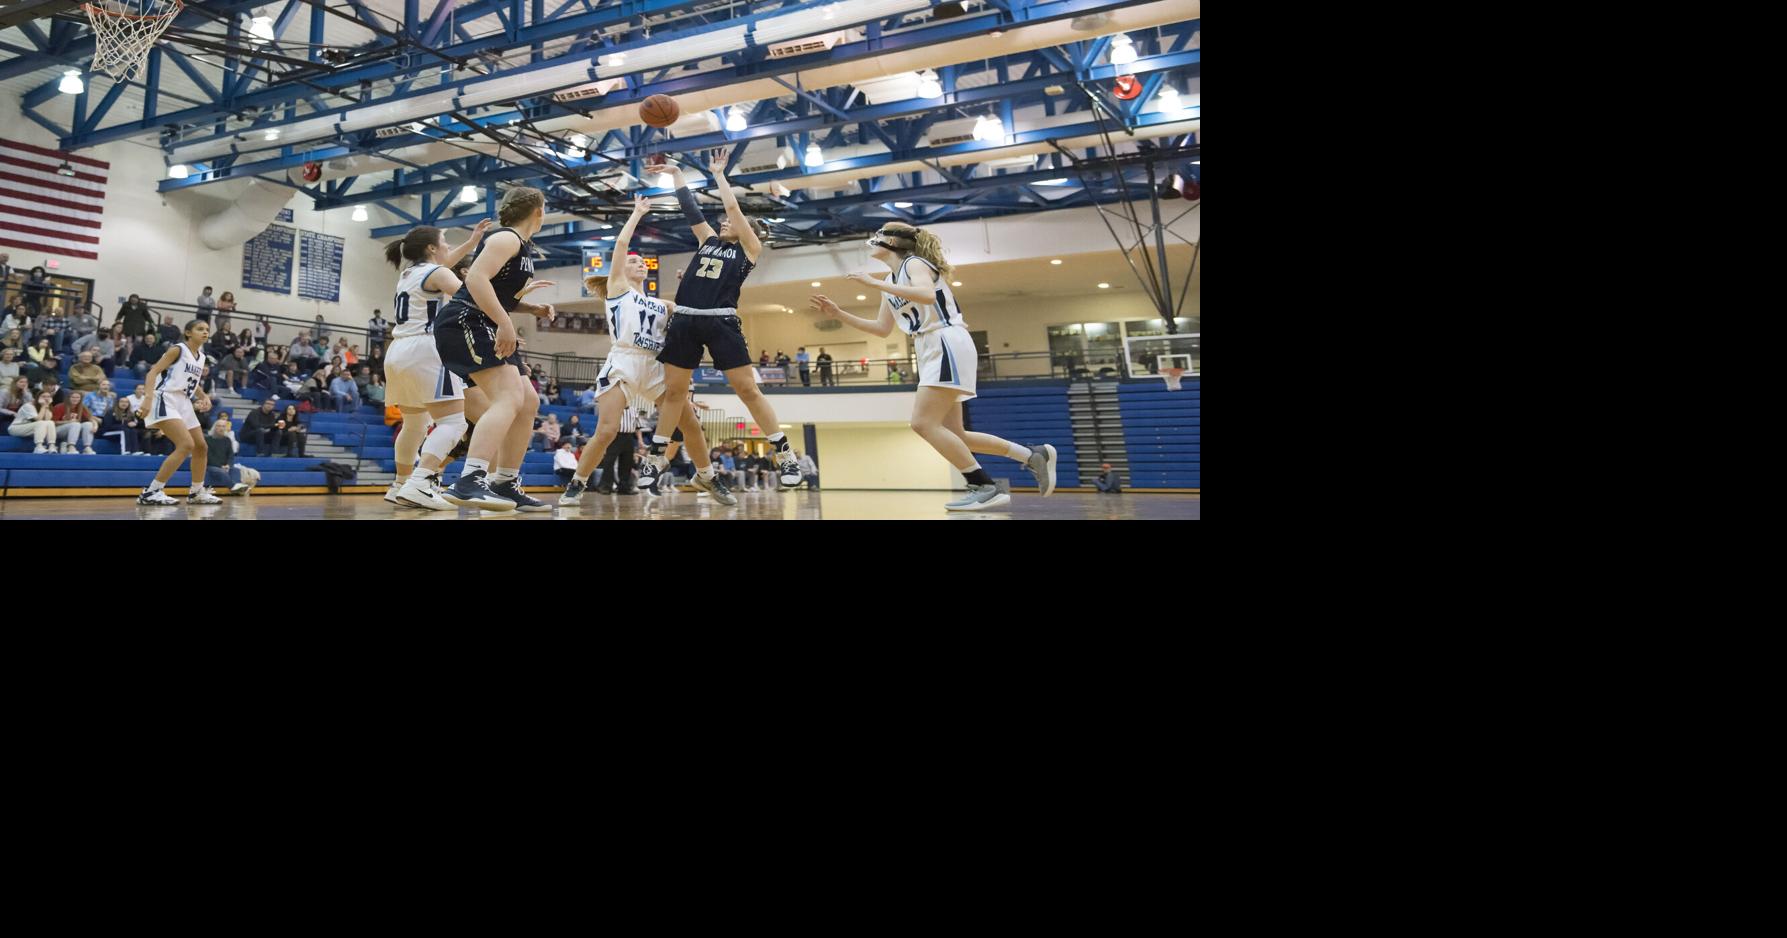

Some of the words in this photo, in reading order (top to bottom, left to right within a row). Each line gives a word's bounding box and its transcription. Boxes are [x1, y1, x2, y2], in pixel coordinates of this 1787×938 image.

[591, 256, 603, 269] 15
[643, 257, 659, 270] 26
[695, 257, 724, 279] 23
[649, 281, 657, 291] 0
[394, 290, 410, 325] 0
[639, 309, 656, 336] 11
